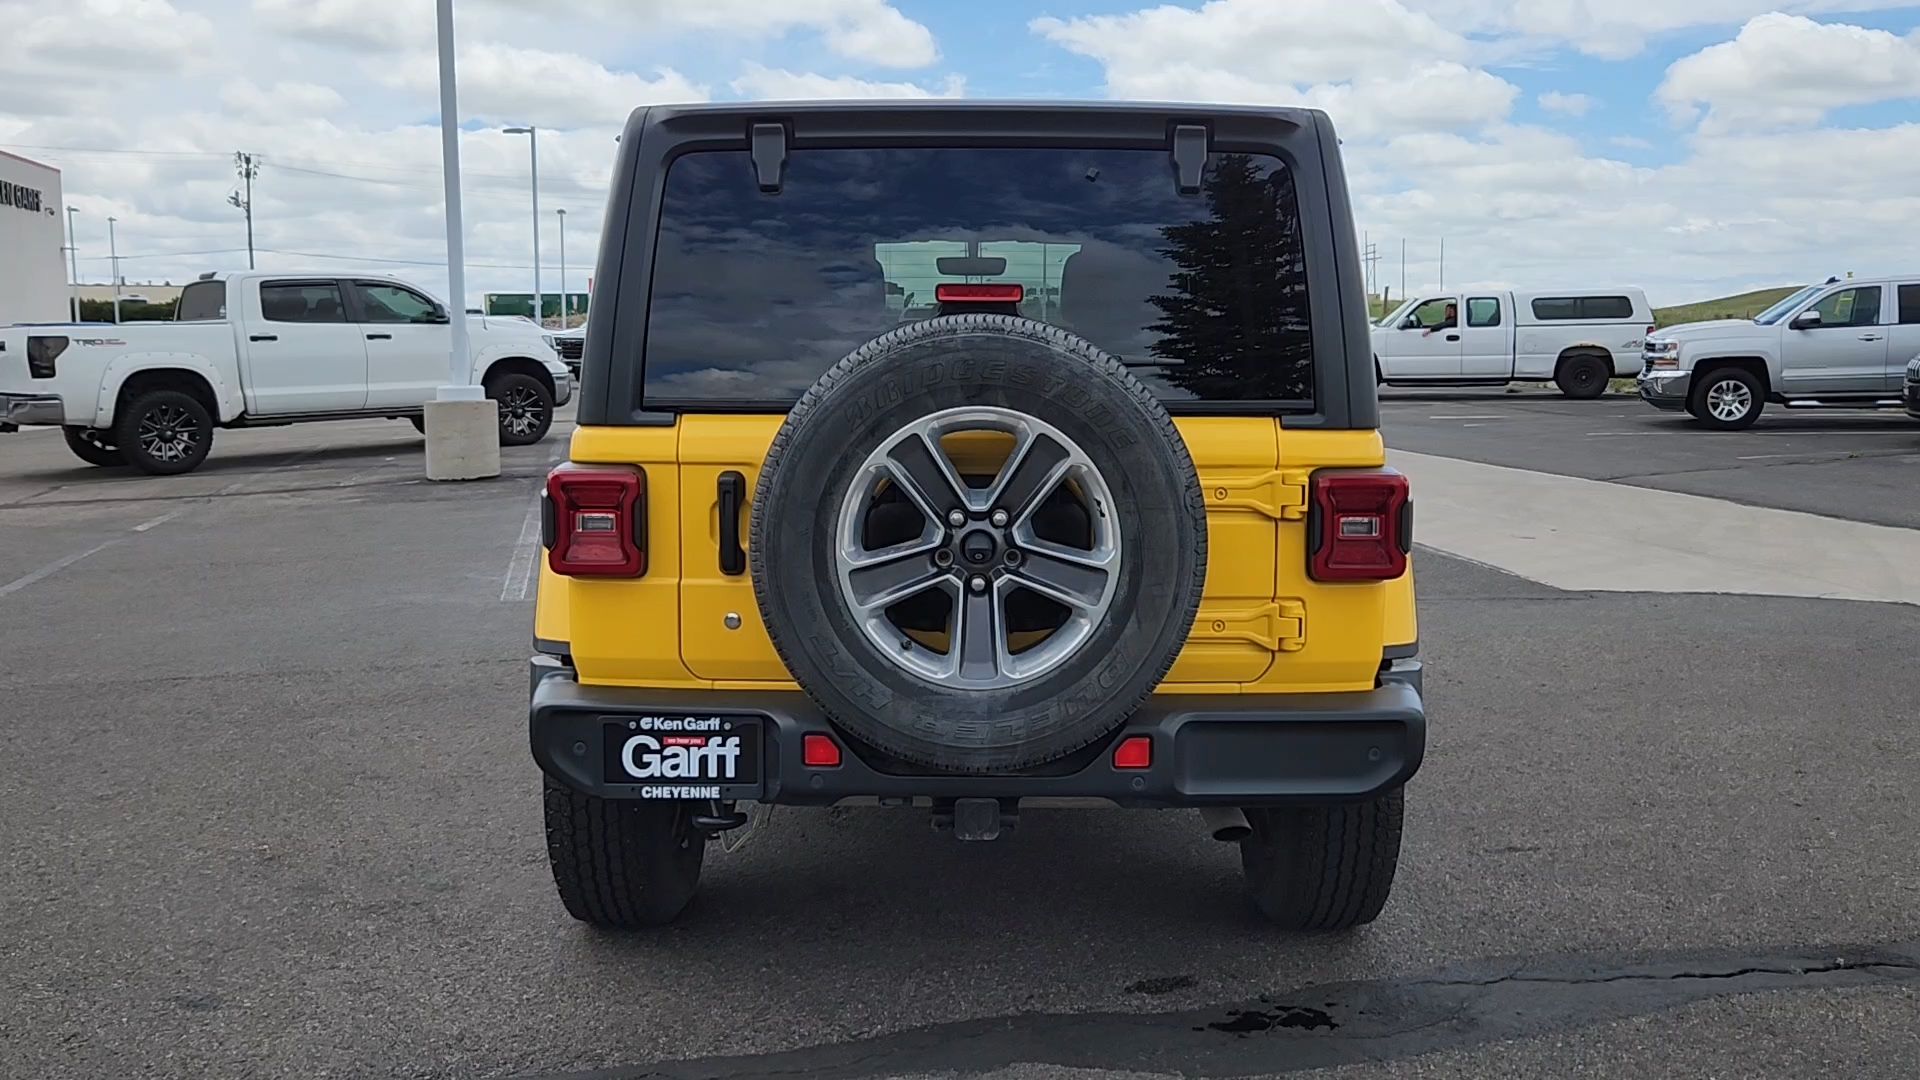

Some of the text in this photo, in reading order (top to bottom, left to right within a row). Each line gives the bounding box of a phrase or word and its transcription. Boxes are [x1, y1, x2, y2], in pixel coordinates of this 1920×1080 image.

[845, 358, 1137, 450] BRIDGESTONE
[912, 652, 1128, 745] DUELER
[653, 717, 720, 731] Ken Garff
[621, 734, 740, 778] Garff
[641, 786, 720, 799] CHEYENNE
